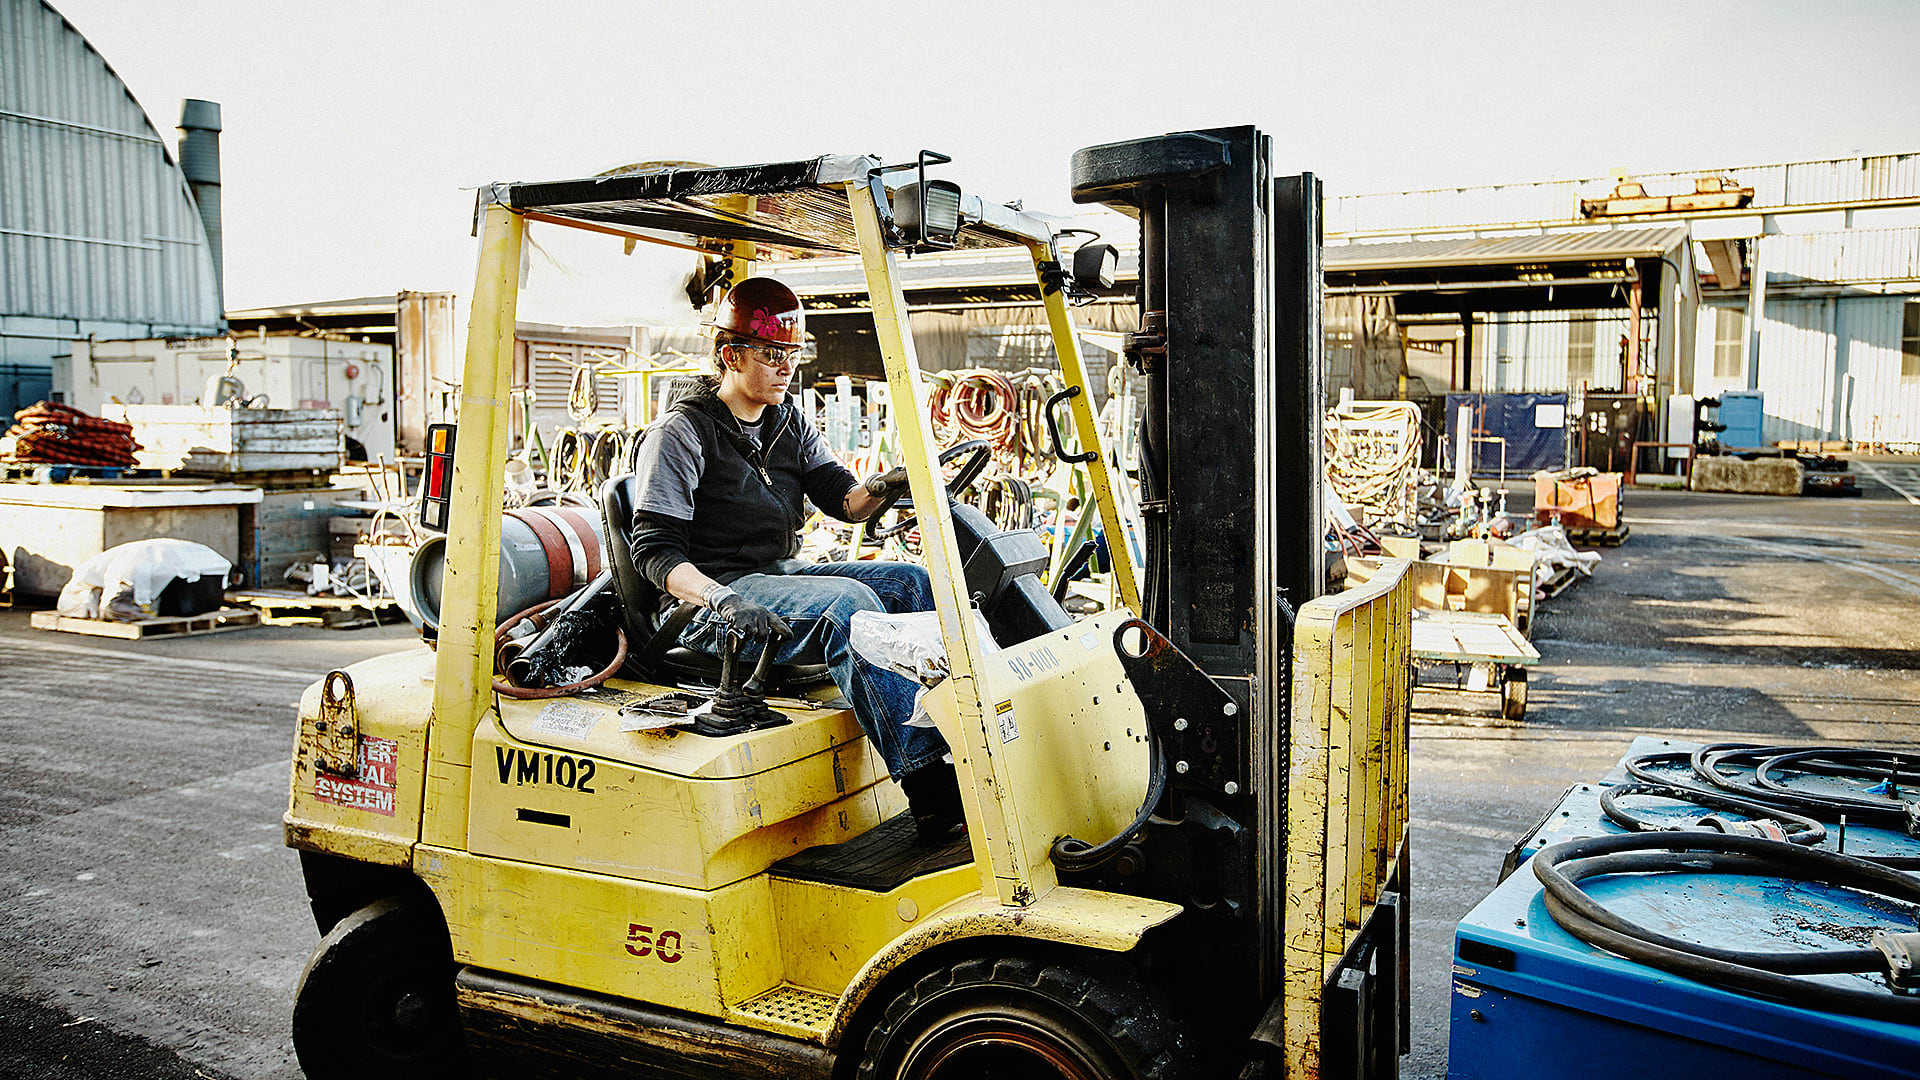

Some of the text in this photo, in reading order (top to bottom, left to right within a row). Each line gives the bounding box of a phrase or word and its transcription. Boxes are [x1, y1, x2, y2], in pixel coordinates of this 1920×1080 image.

[495, 745, 597, 795] VM102
[316, 777, 393, 812] SYSTEM
[624, 922, 684, 964] 50
